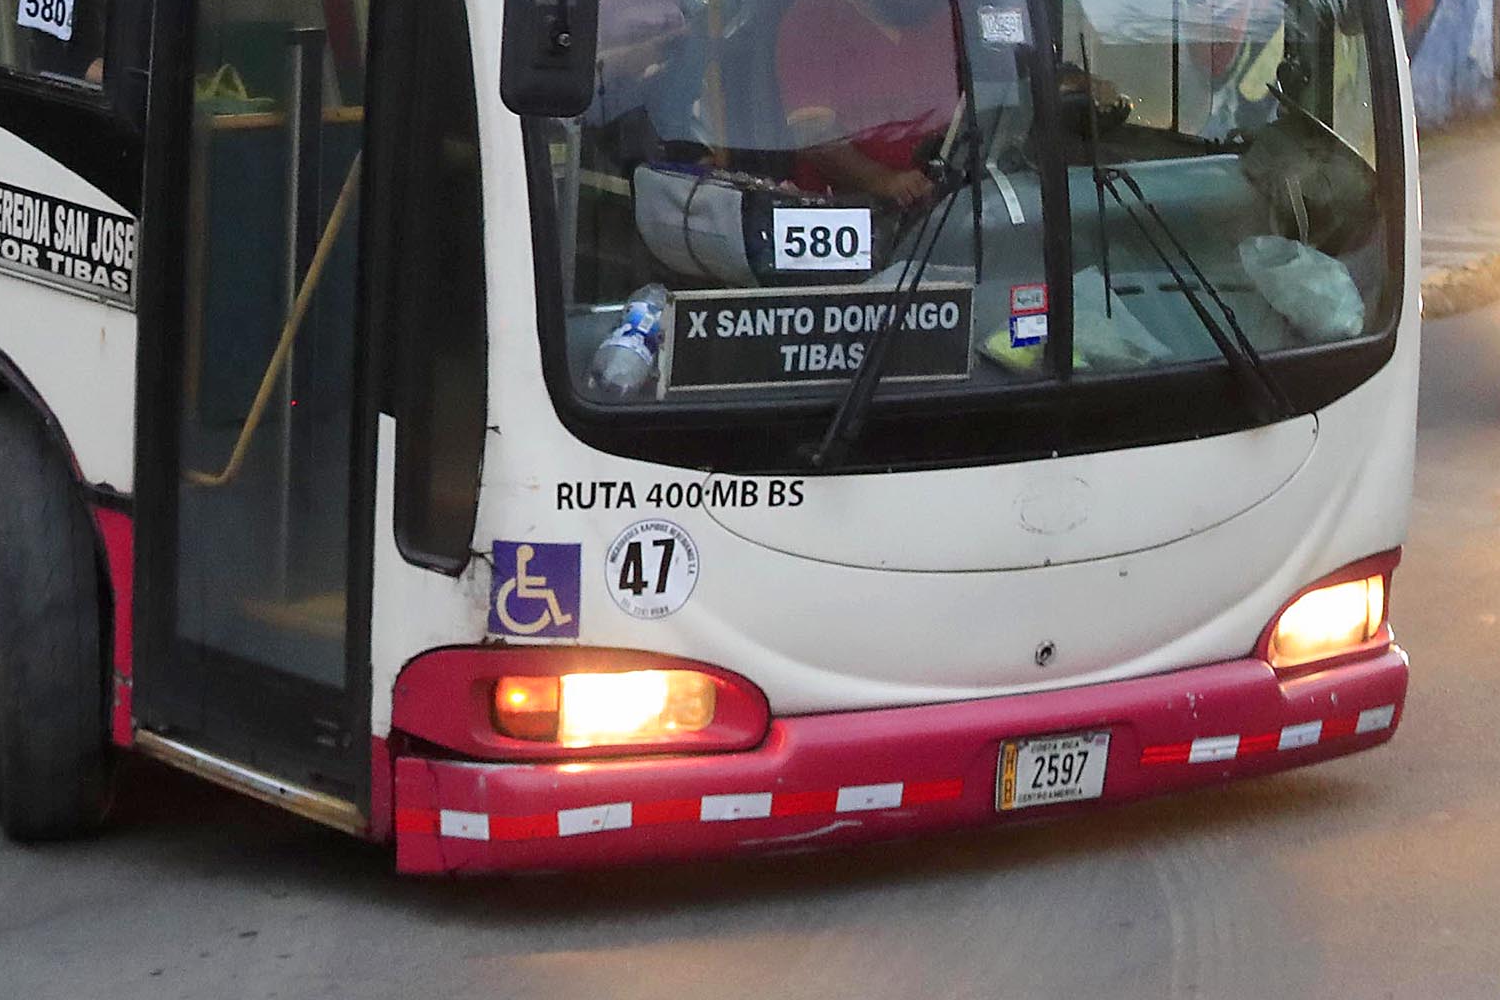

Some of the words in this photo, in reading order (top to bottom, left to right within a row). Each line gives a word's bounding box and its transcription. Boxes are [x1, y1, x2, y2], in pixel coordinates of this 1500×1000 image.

[54, 204, 89, 258] SAN
[91, 216, 135, 270] JOSE
[784, 225, 859, 259] 580
[46, 251, 130, 293] TIBAS
[687, 311, 708, 339] X
[716, 307, 815, 338] SANTO
[780, 342, 865, 373] TIBAS
[557, 482, 636, 510] RUTA
[646, 482, 703, 508] 400
[711, 480, 759, 507] MB
[768, 480, 804, 507] BS
[619, 538, 675, 596] 47
[1032, 751, 1089, 789] 2597
